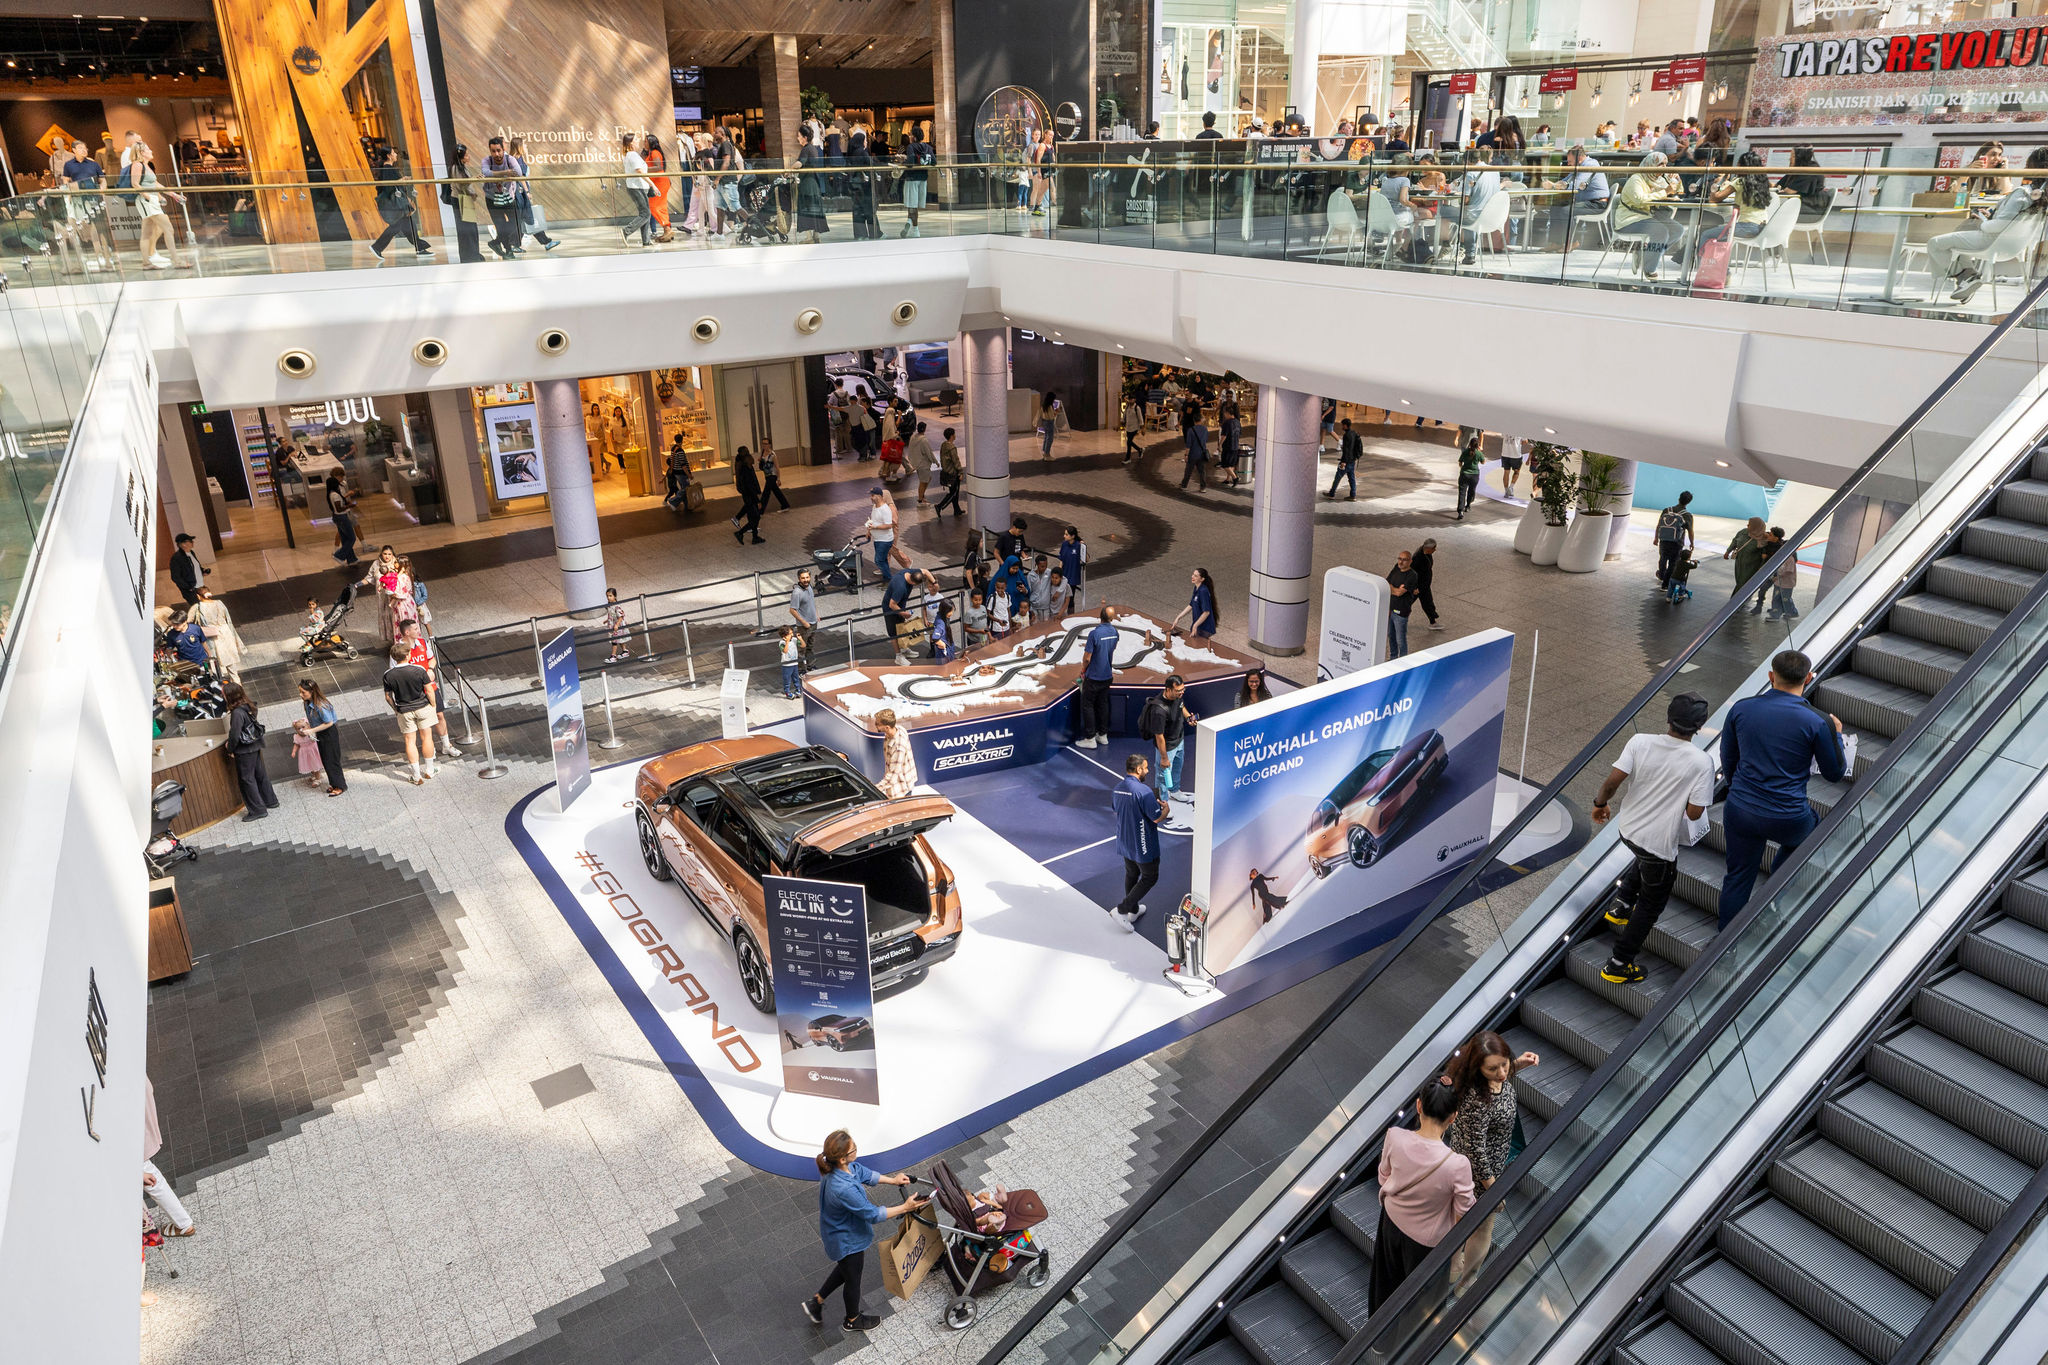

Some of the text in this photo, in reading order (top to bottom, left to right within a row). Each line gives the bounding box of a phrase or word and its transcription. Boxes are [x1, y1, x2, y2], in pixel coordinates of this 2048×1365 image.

[1807, 95, 1873, 110] SPANISH
[1874, 93, 1908, 108] BAR
[1908, 93, 1946, 107] AND
[598, 130, 610, 142] &
[525, 147, 606, 165] bercrombie
[289, 406, 316, 414] Designed
[324, 396, 381, 427] JUUL
[1328, 630, 1367, 647] CELEBRATE YOUR
[1332, 637, 1349, 647] RACING
[410, 654, 426, 665] JVC
[547, 646, 573, 670] GRANDLAND
[932, 728, 1014, 750] VAUXHALL
[1233, 697, 1413, 769] VAUXHALL GRANDLAND
[970, 742, 978, 752] X
[1234, 732, 1265, 753] NEW
[938, 748, 1009, 768] SCALEXTRIC
[1233, 755, 1304, 790] #GOGRAND
[1139, 818, 1148, 856] VAUXHALL
[1450, 835, 1485, 853] VAUXHALL
[778, 889, 824, 903] ELECTRIC
[779, 899, 825, 914] ALL IN
[889, 946, 911, 958] Electric
[574, 850, 762, 1073] #GOGRAND
[820, 1075, 855, 1084] VAUXHALL
[902, 1234, 926, 1284] Boots
